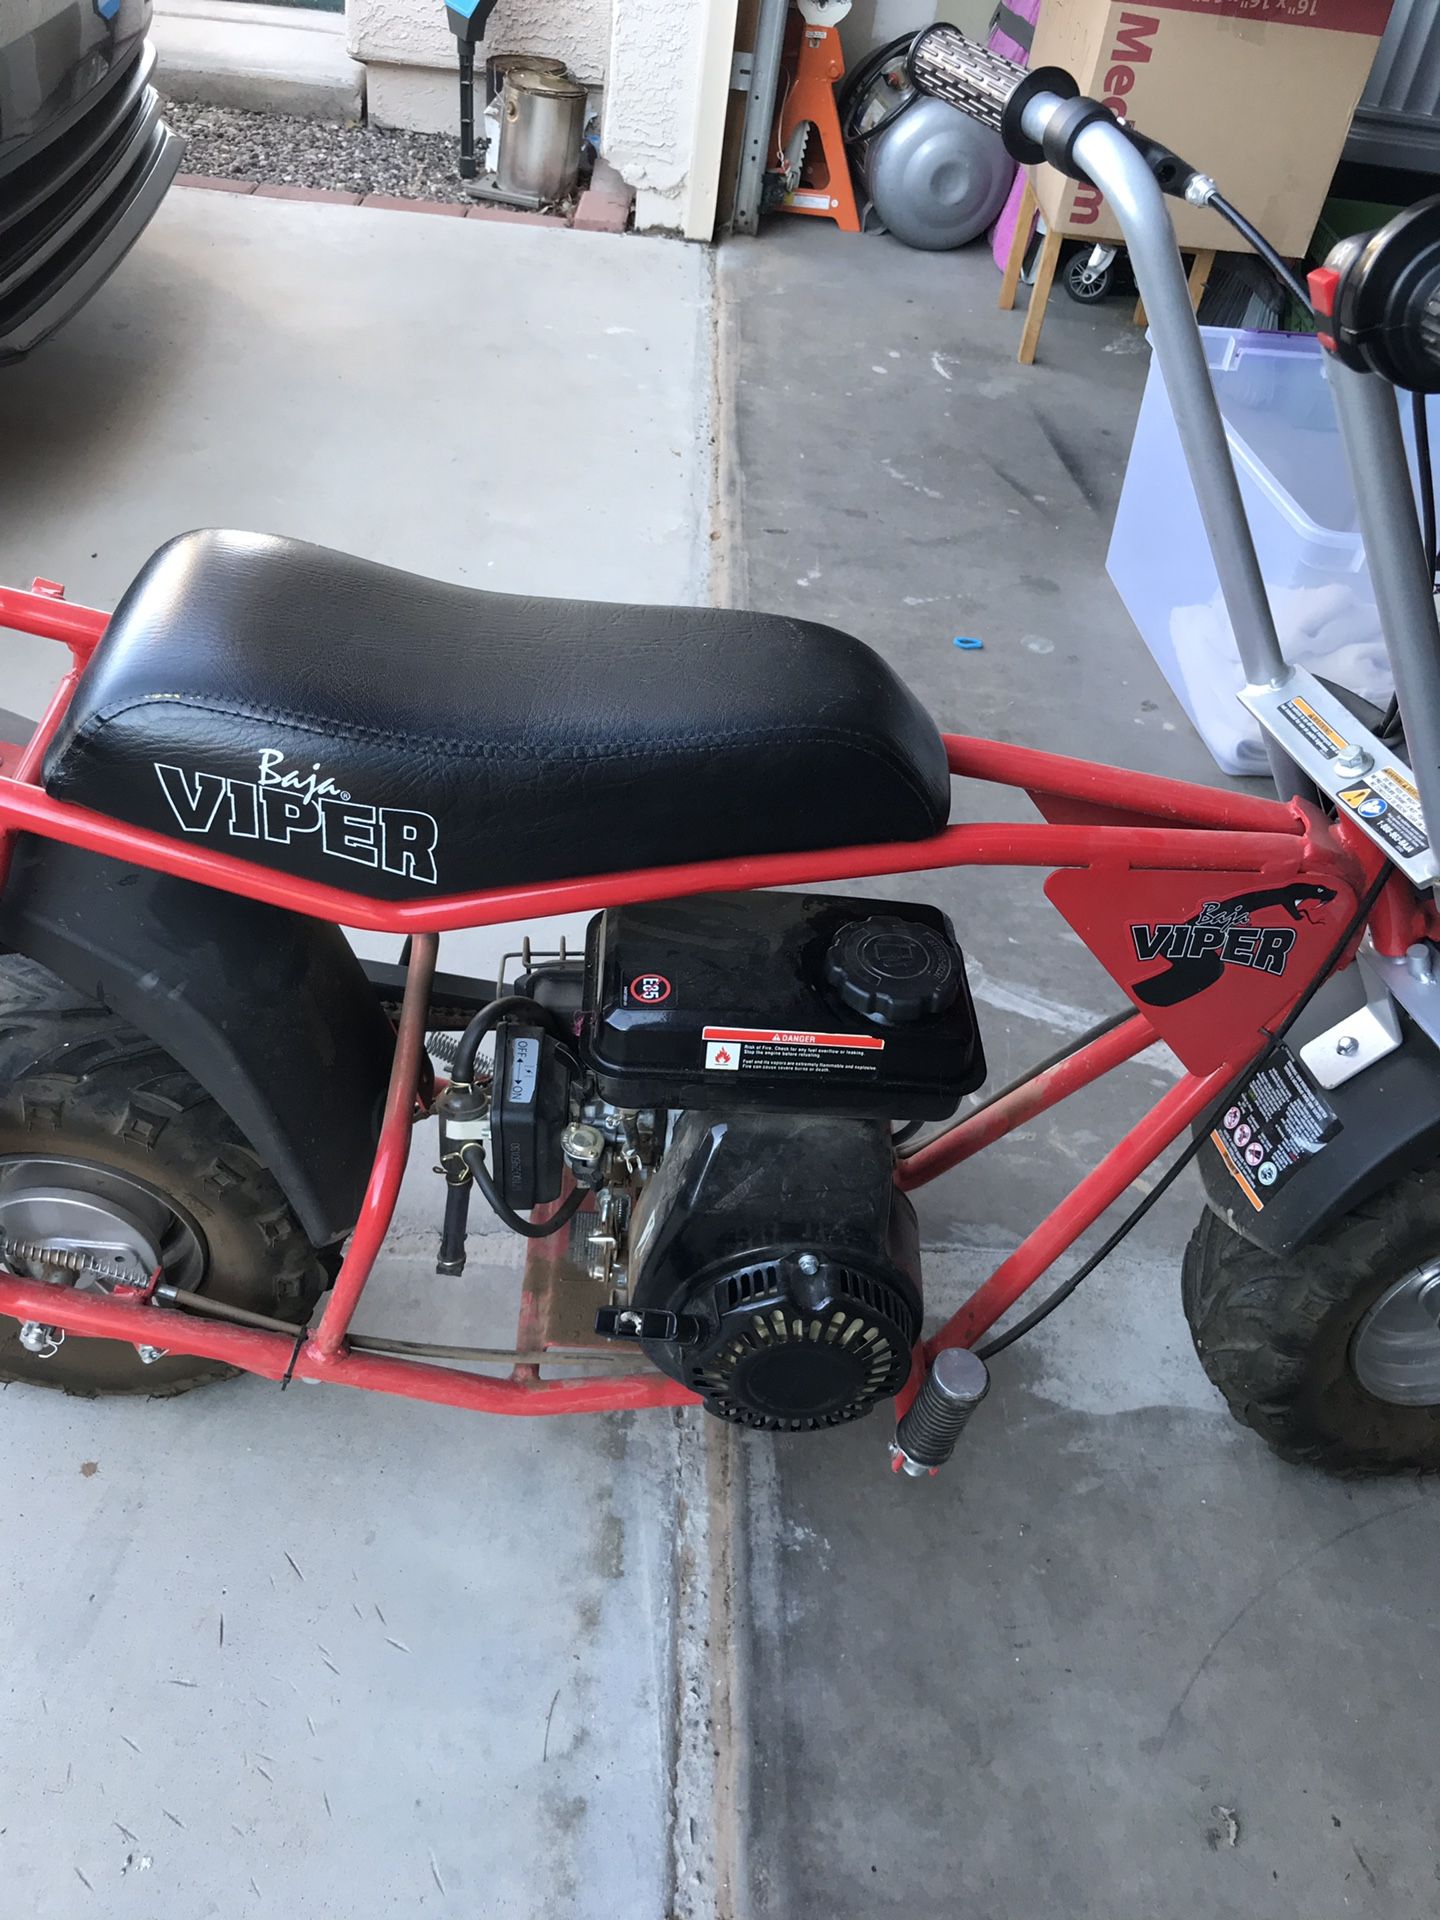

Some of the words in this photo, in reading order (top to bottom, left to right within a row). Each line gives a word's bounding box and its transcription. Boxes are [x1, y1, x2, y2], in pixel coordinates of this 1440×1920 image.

[154, 762, 438, 884] VIPER
[1195, 902, 1251, 932] Baja
[1131, 924, 1297, 977] VIPER
[643, 978, 660, 999] E85
[517, 1040, 529, 1058] OFF
[782, 1034, 816, 1043] DANGER
[512, 1086, 523, 1100] ON
